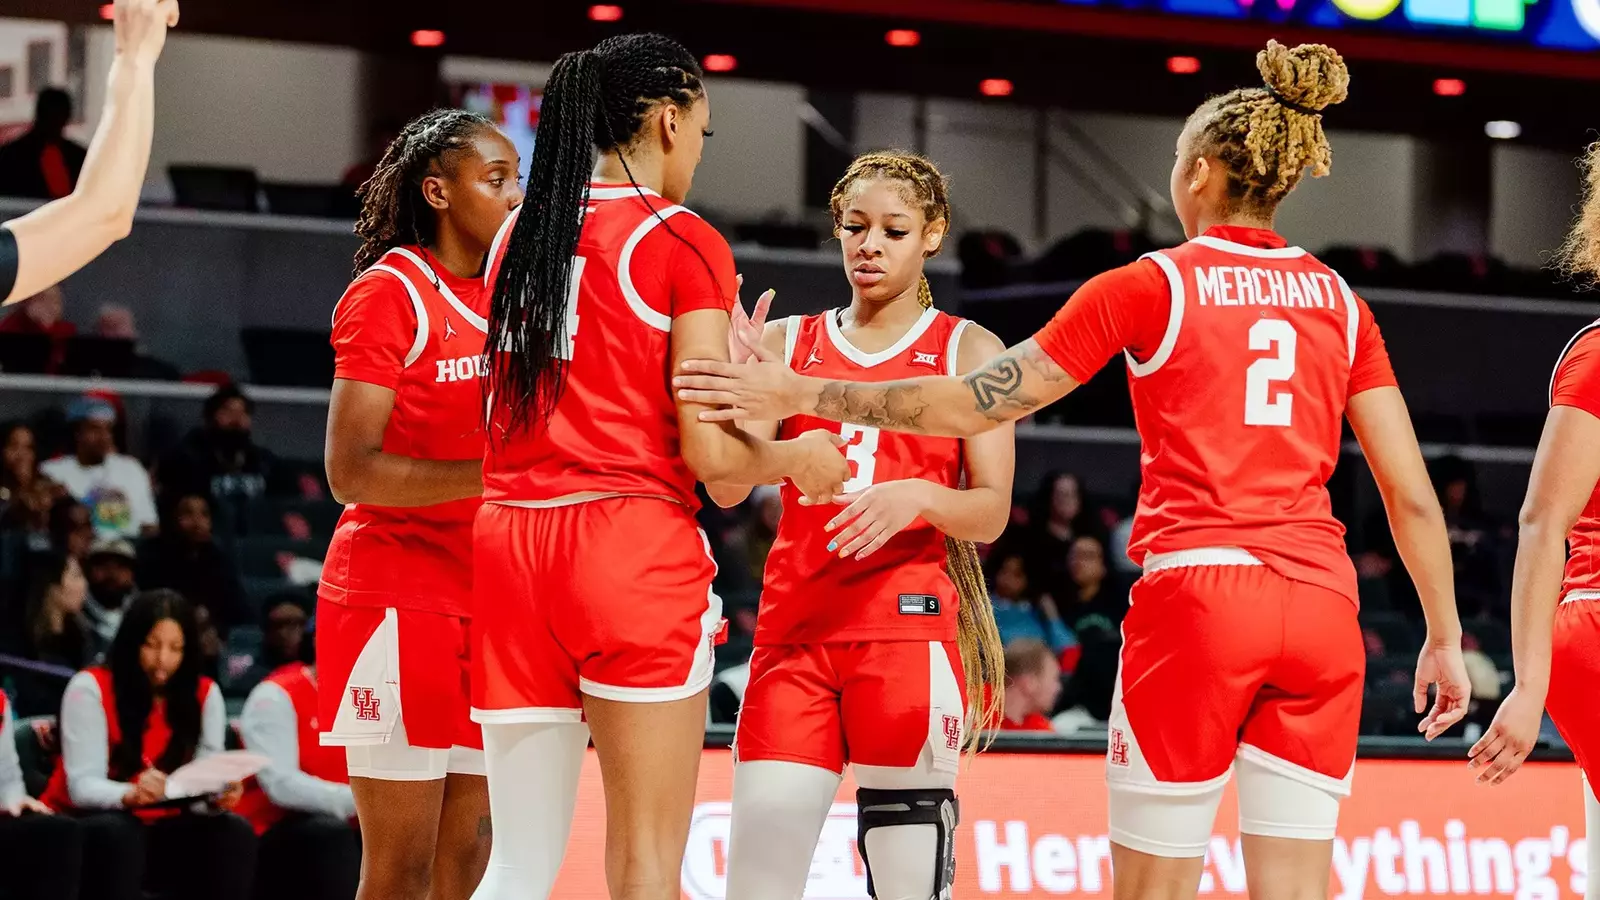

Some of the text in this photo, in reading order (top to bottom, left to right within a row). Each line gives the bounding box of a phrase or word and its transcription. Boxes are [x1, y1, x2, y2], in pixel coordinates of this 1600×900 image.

[1194, 266, 1335, 310] MERCHANT
[1244, 318, 1298, 427] 2
[839, 422, 881, 494] 3
[929, 600, 936, 610] S
[350, 686, 381, 721] UH
